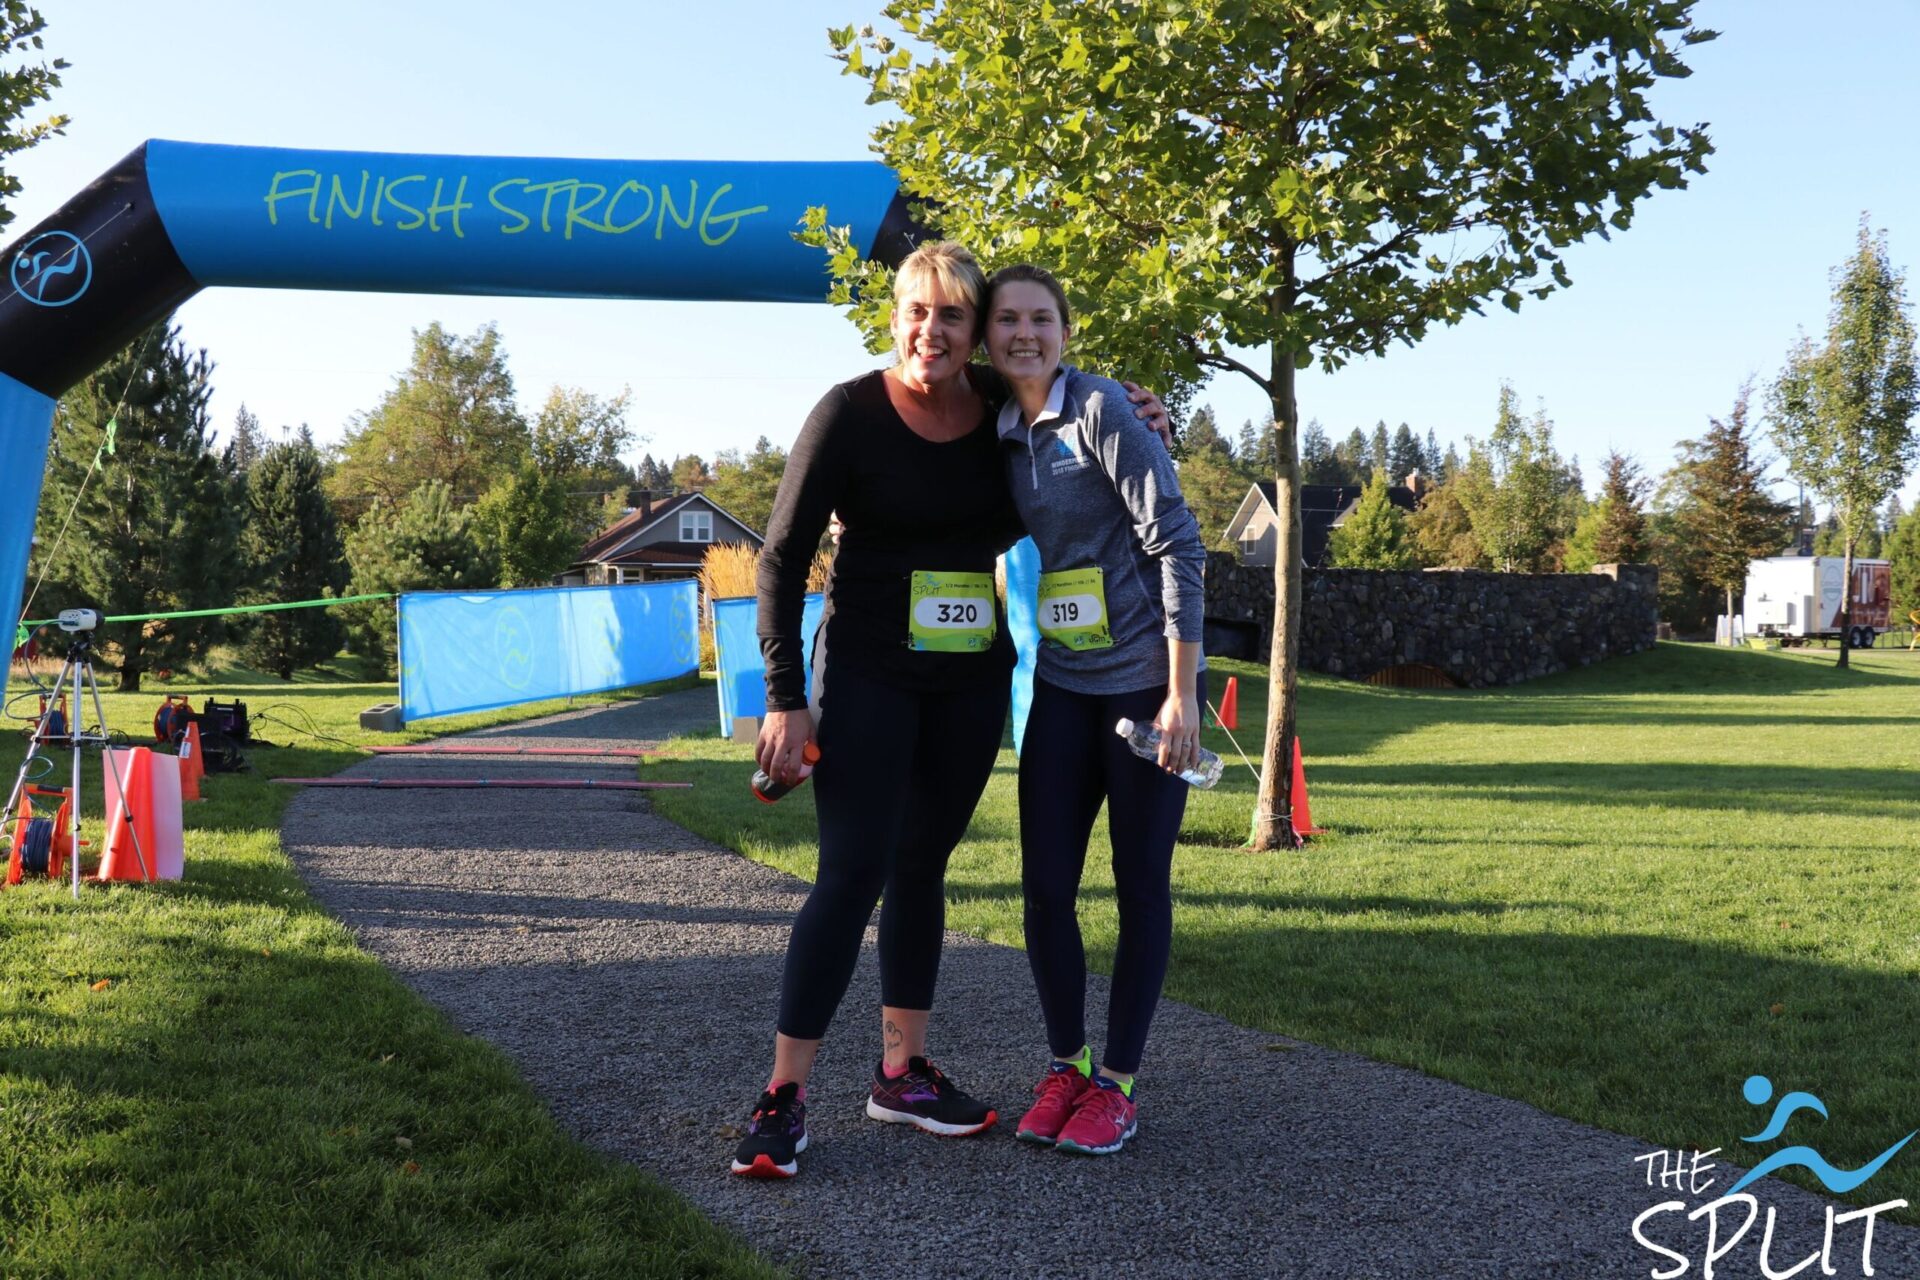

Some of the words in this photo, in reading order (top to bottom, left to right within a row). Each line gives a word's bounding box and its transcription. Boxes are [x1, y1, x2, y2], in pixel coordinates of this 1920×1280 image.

[264, 171, 471, 238] FINISH
[488, 178, 768, 246] STRONG
[937, 604, 977, 623] 320
[1052, 602, 1079, 623] 319
